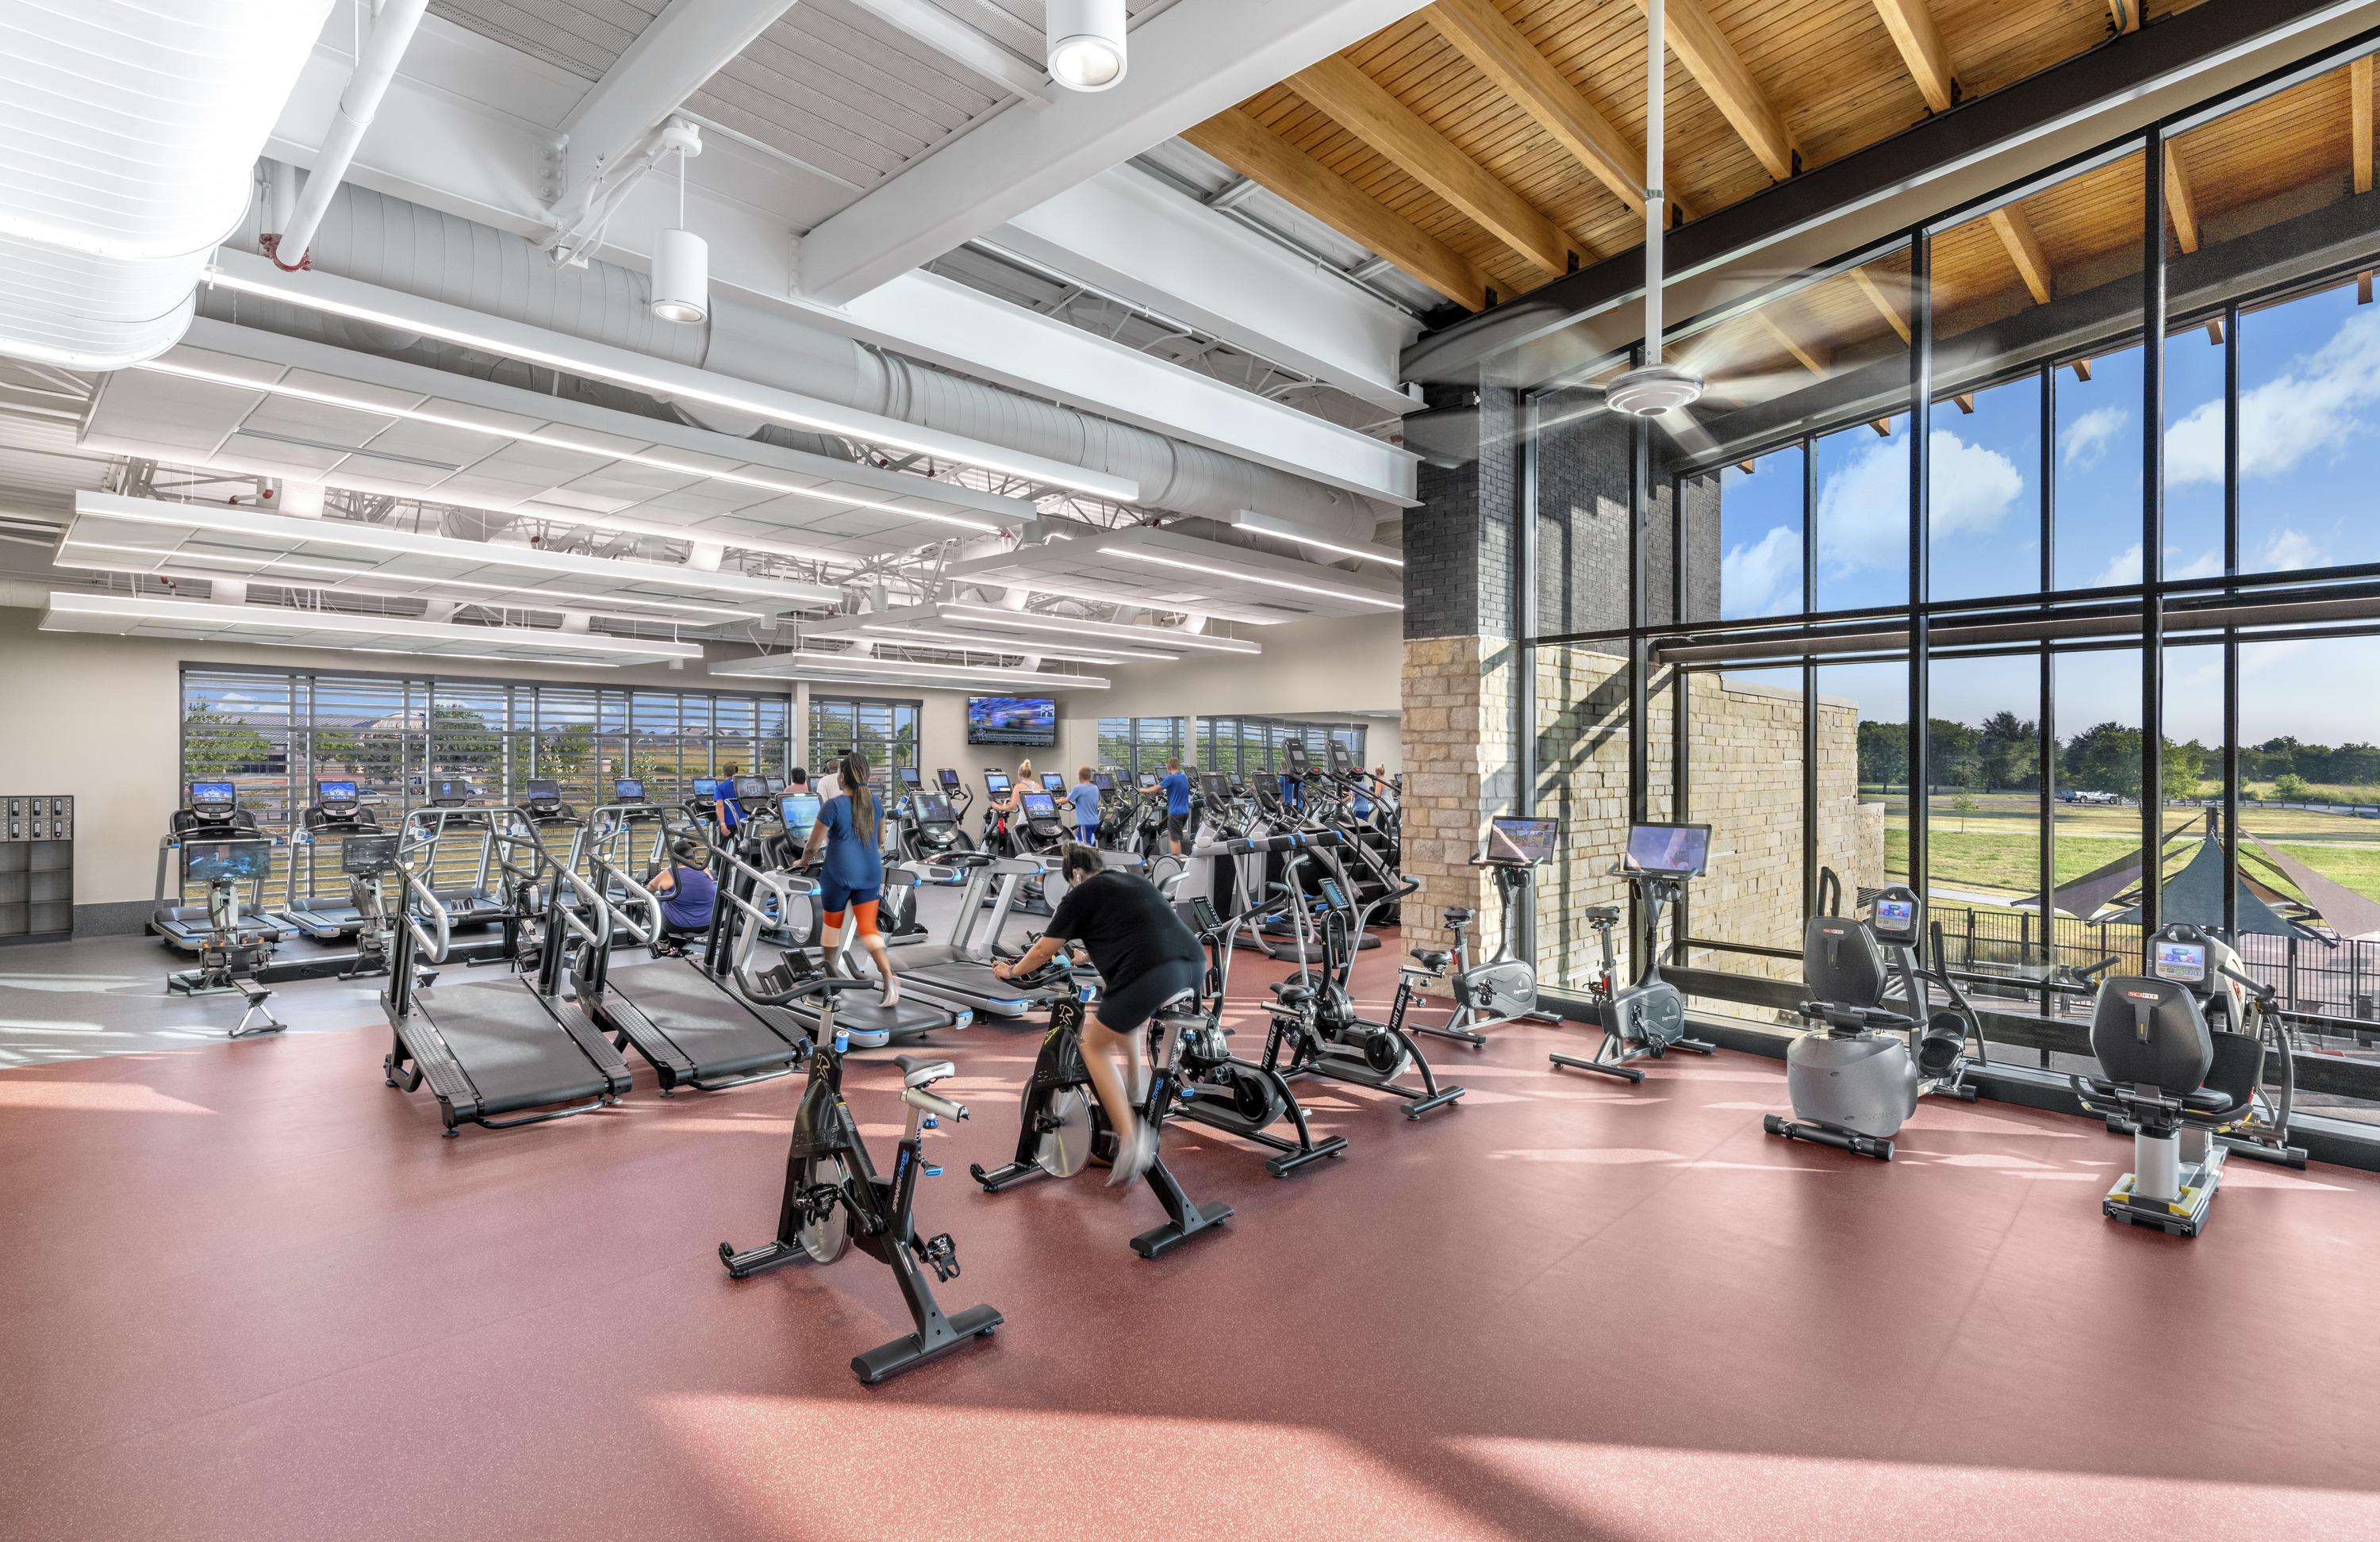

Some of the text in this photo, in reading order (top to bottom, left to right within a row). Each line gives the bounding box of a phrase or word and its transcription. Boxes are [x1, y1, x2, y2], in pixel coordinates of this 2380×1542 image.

[1392, 988, 1406, 1029] HIIT BIKE
[1262, 1023, 1277, 1070] HIIT BIKE
[1152, 1077, 1161, 1101] Chrono
[892, 1150, 908, 1214] SPINNER Chrono
